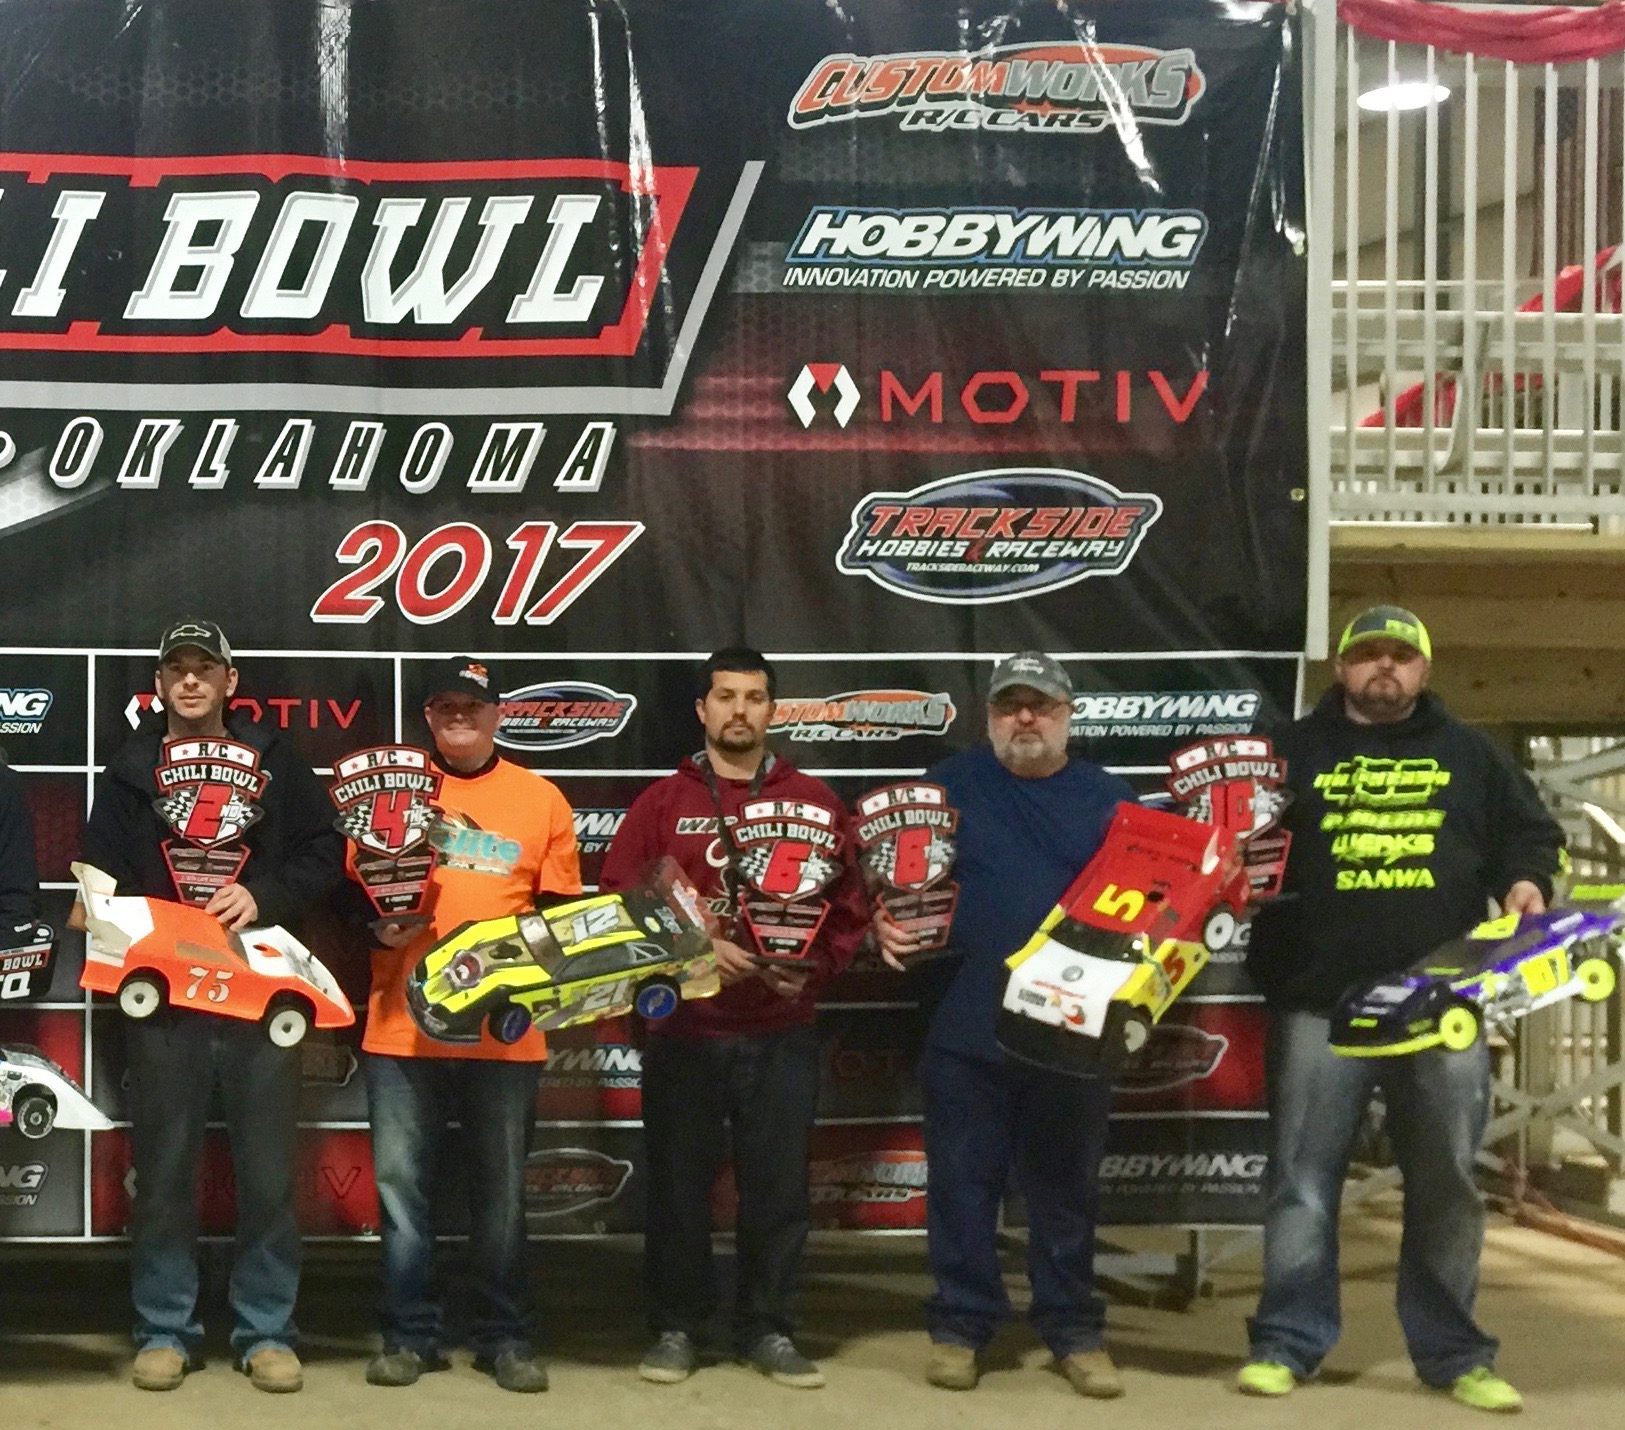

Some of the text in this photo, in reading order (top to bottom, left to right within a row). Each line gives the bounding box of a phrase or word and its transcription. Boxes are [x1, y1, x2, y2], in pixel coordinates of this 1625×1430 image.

[795, 53, 1193, 113] CUSTOMWORKS
[797, 213, 1200, 261] HOBBYWING
[122, 190, 605, 325] BOWL
[782, 266, 1190, 290] INNOVATION POWERED BY PASSION
[880, 369, 1210, 424] MOTIV
[49, 415, 619, 494] OKLAHOMA
[868, 506, 1142, 539] TRACKSIDE
[856, 538, 972, 557] HOBBIES
[984, 540, 1125, 557] RACEWAY
[310, 520, 646, 625] 2017
[229, 698, 362, 729] OTIV
[500, 701, 627, 716] RACKSIDE
[769, 698, 948, 726] STOMWORKS
[1071, 693, 1258, 720] OBBYWING
[549, 717, 620, 727] RACEWAY
[1110, 724, 1172, 737] POWERED
[1175, 724, 1194, 737] BY
[1196, 723, 1252, 735] PASSION
[159, 764, 260, 793] CHILI BOWL
[334, 772, 435, 804] CHILI BOWL
[735, 822, 784, 843] CHILI
[786, 822, 837, 851] BOWL
[1335, 867, 1436, 891] SANWA
[1092, 883, 1146, 923] 5
[2, 952, 44, 972] BOWL
[184, 966, 234, 1004] 75
[1099, 1155, 1268, 1179] BBYWING
